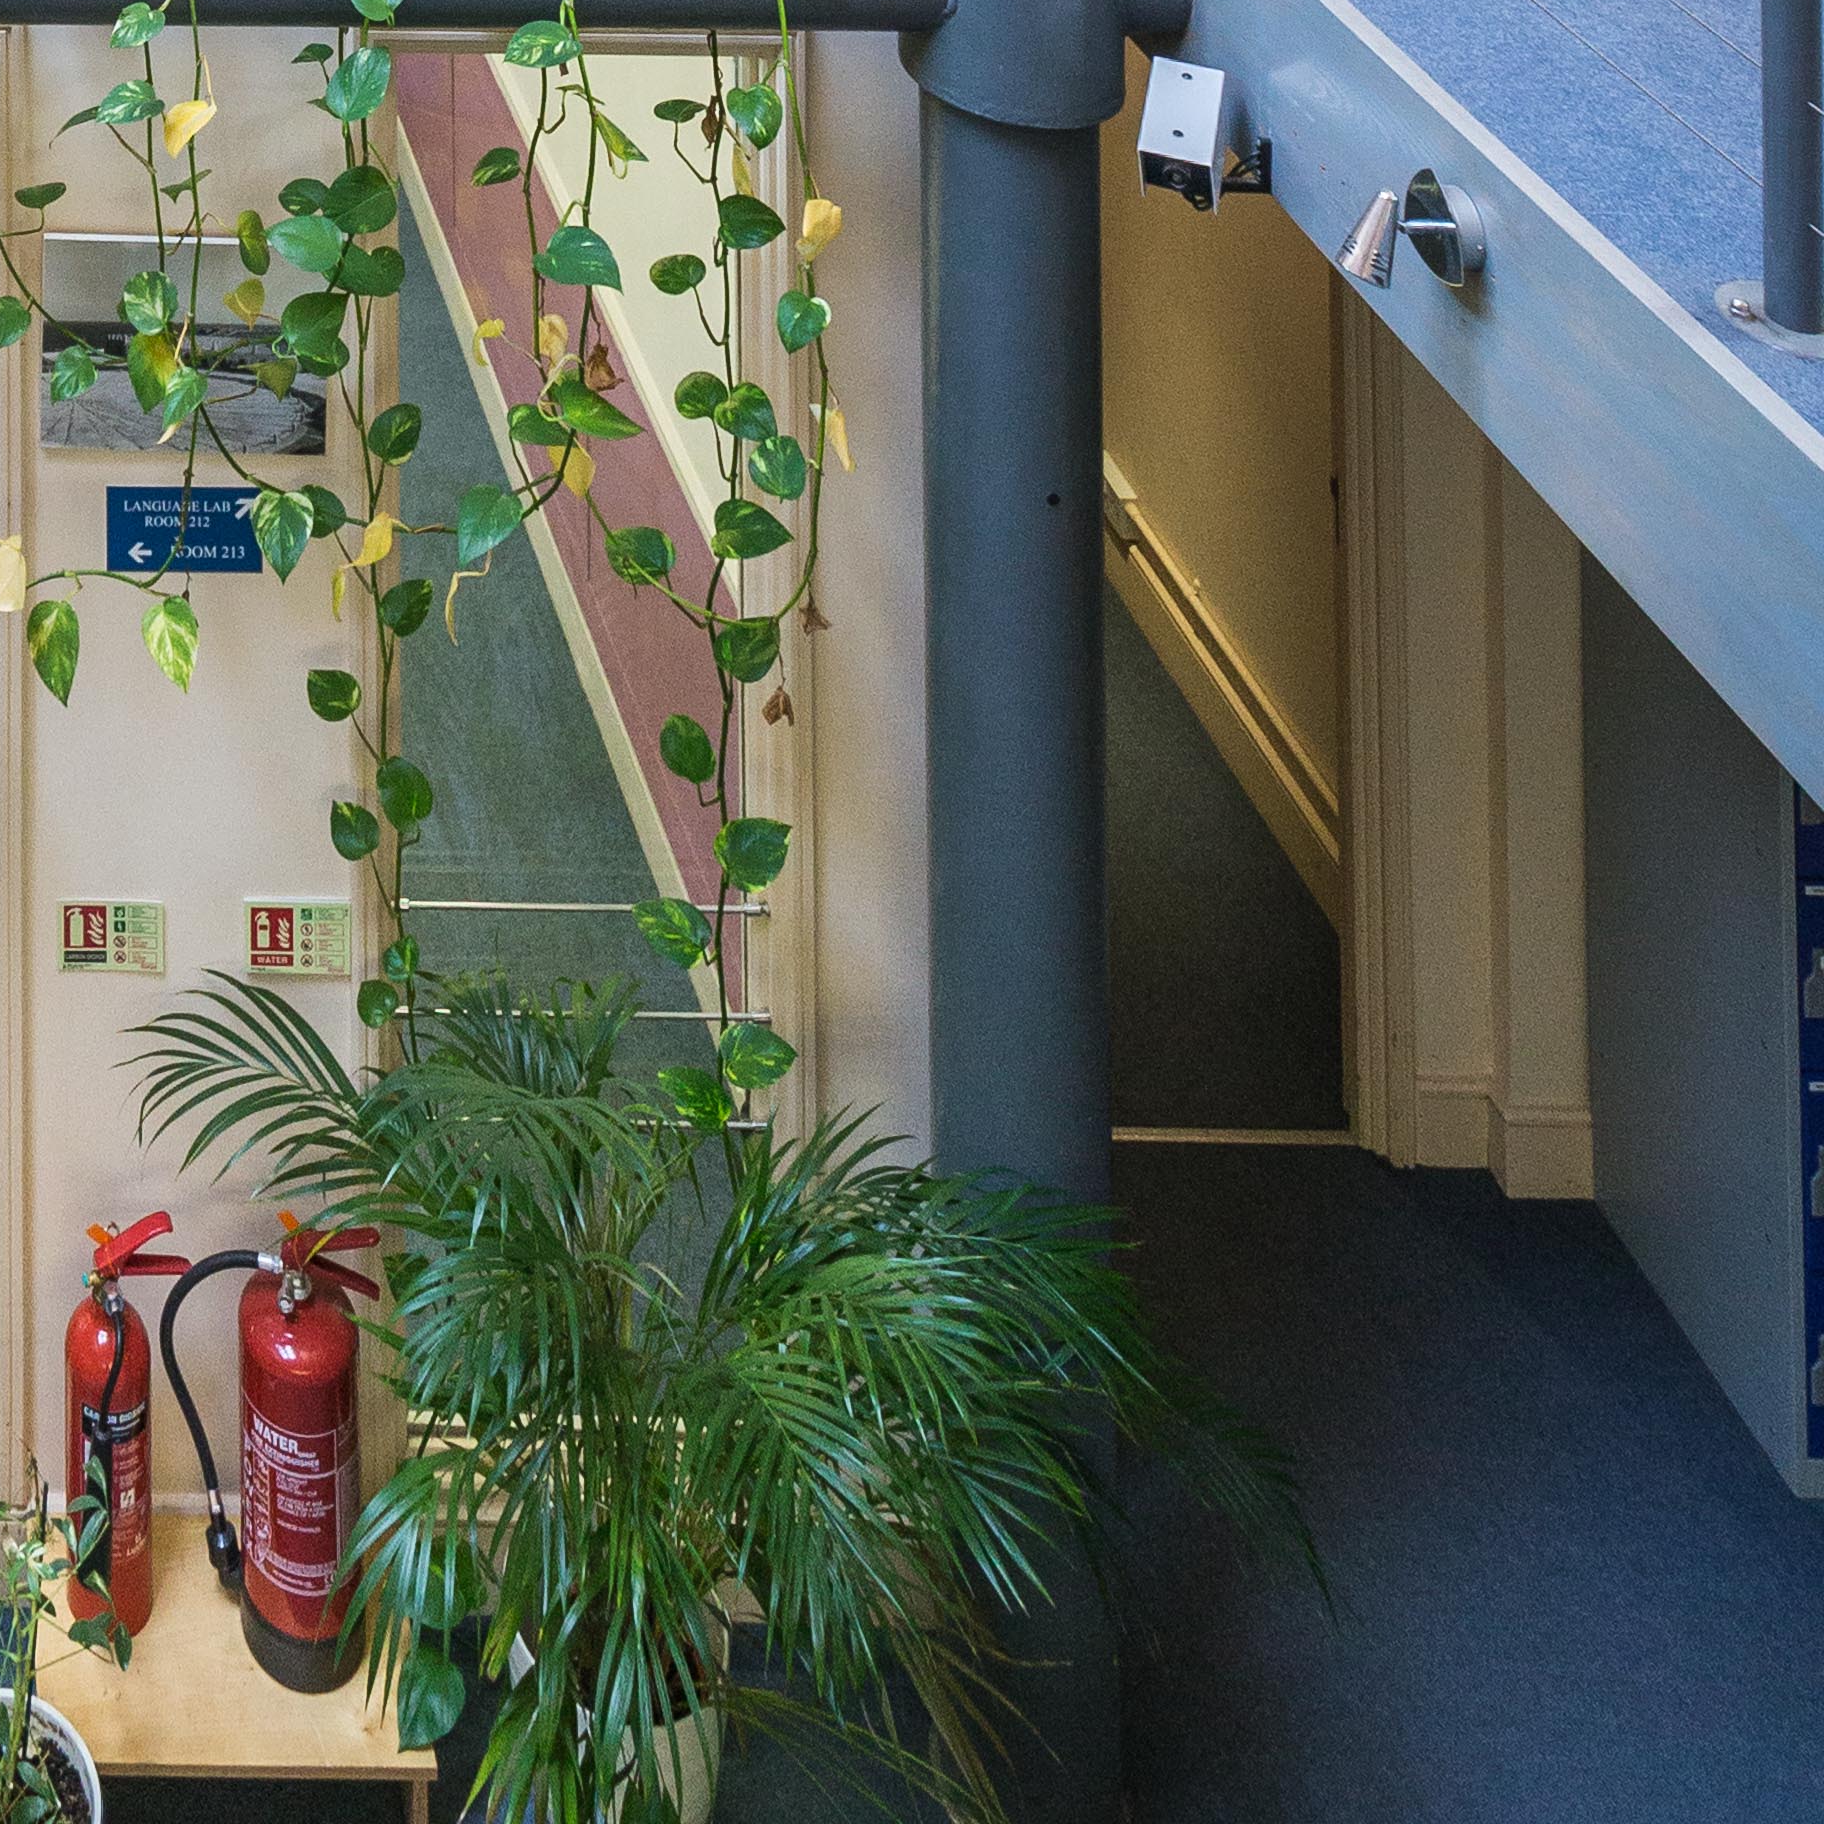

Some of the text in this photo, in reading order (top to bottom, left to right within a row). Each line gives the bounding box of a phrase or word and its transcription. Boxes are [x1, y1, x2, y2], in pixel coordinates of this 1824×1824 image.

[204, 500, 231, 512] LAB
[189, 516, 210, 527] 212
[221, 545, 245, 559] 213
[257, 955, 288, 964] WATER
[83, 1405, 117, 1424] CARON
[253, 1413, 298, 1454] WATER
